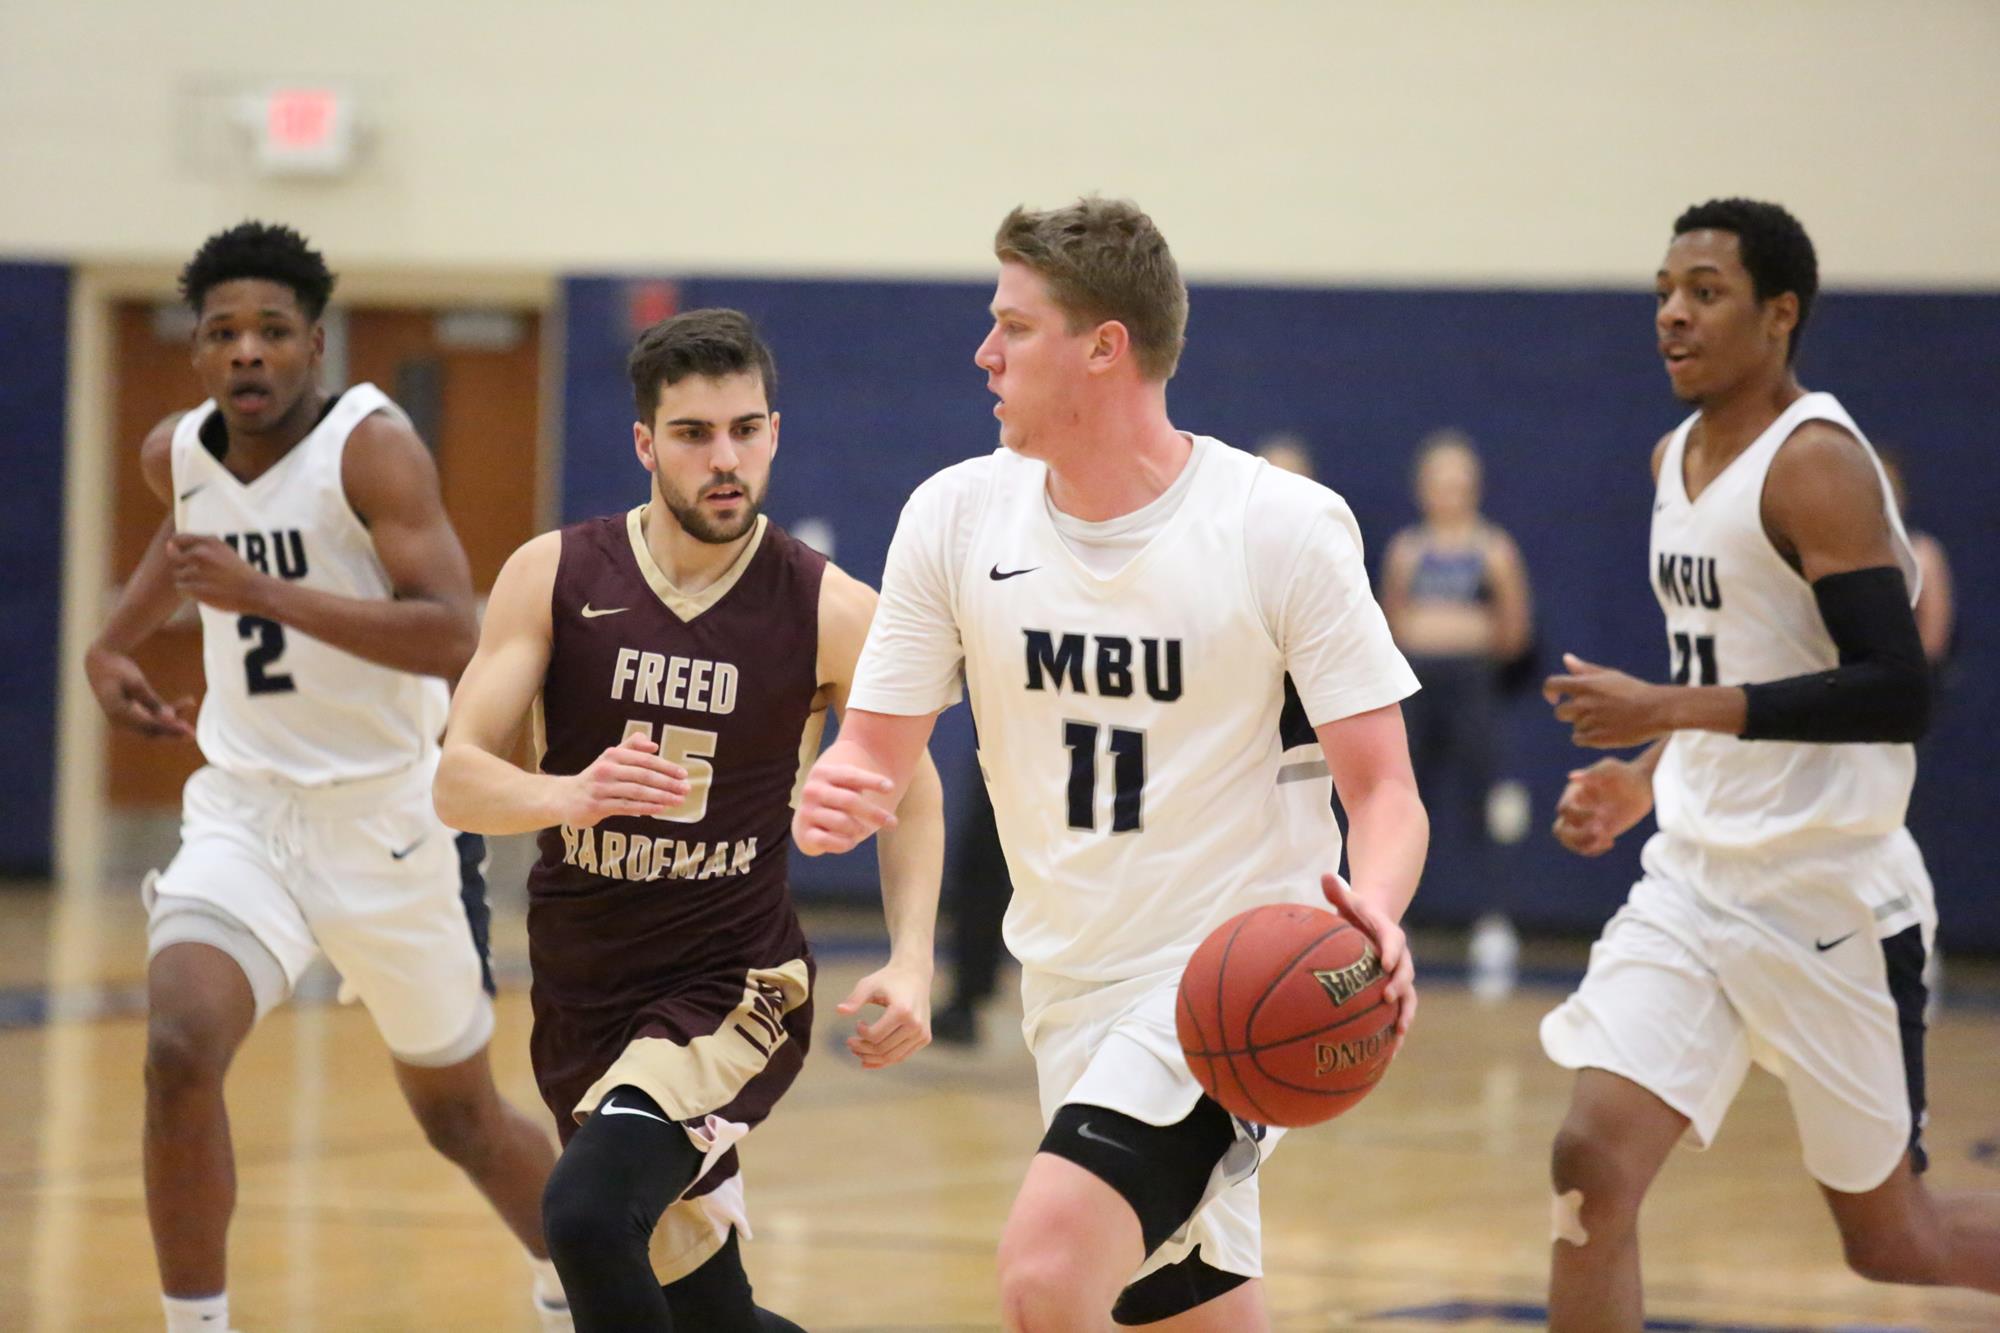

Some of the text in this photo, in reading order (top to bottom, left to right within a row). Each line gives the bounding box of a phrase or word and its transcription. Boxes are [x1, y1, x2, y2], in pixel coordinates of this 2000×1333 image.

[224, 528, 309, 581] BU
[1659, 552, 1722, 611] MBU
[237, 614, 298, 696] 2
[611, 647, 739, 715] FREED
[1021, 627, 1184, 704] MBU
[620, 720, 718, 824] 5
[1061, 717, 1148, 836] 11
